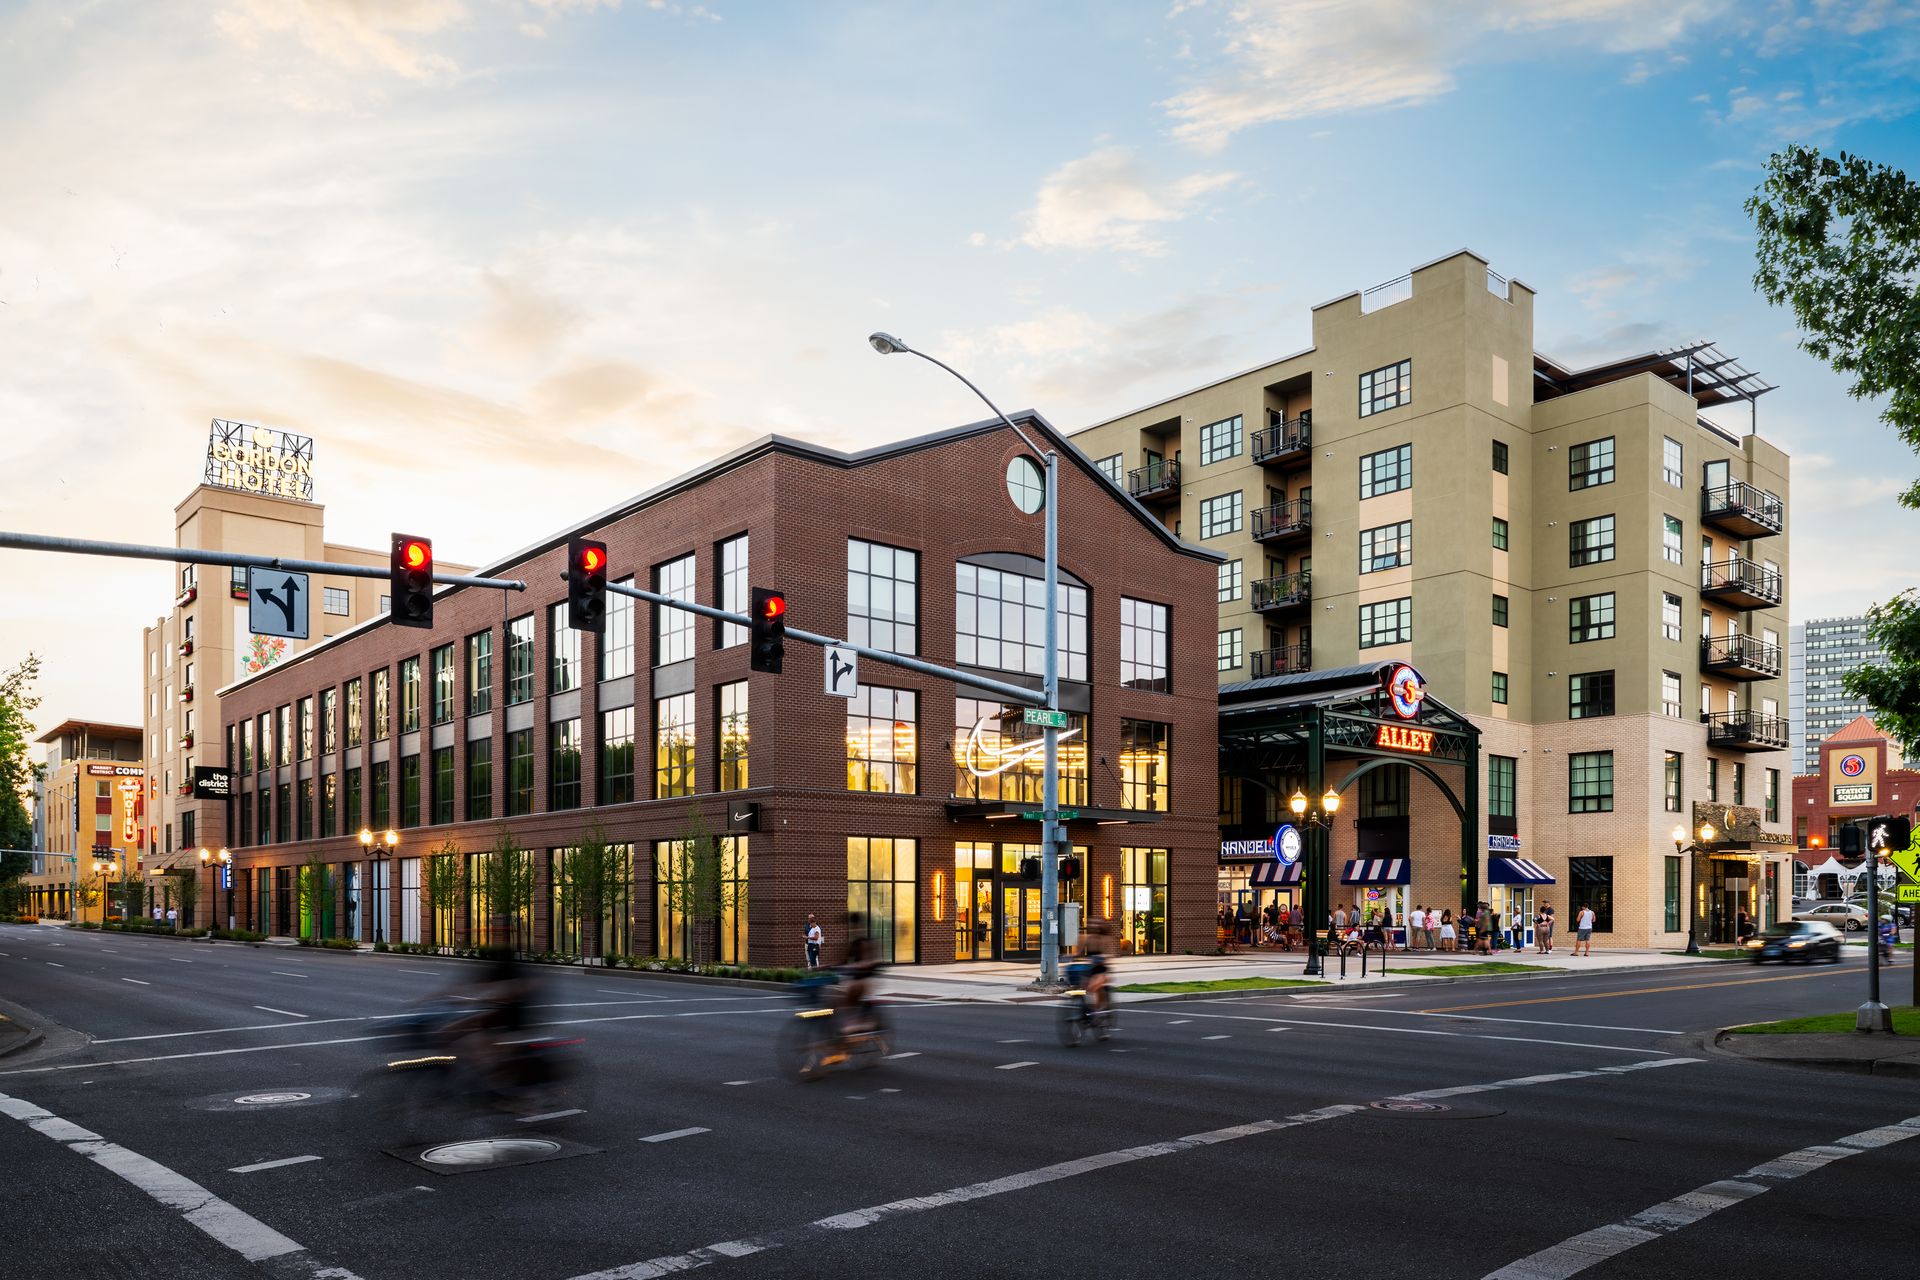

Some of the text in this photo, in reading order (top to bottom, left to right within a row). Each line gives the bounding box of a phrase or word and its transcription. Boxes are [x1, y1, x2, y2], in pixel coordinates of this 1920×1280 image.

[213, 441, 312, 480] GORDON
[221, 466, 308, 498] HOTEL
[1403, 680, 1416, 704] 5
[1026, 711, 1053, 724] PEARL
[1378, 725, 1433, 752] ALLEY
[198, 779, 228, 788] district
[1836, 787, 1870, 795] STATION
[125, 791, 133, 834] HOTEL
